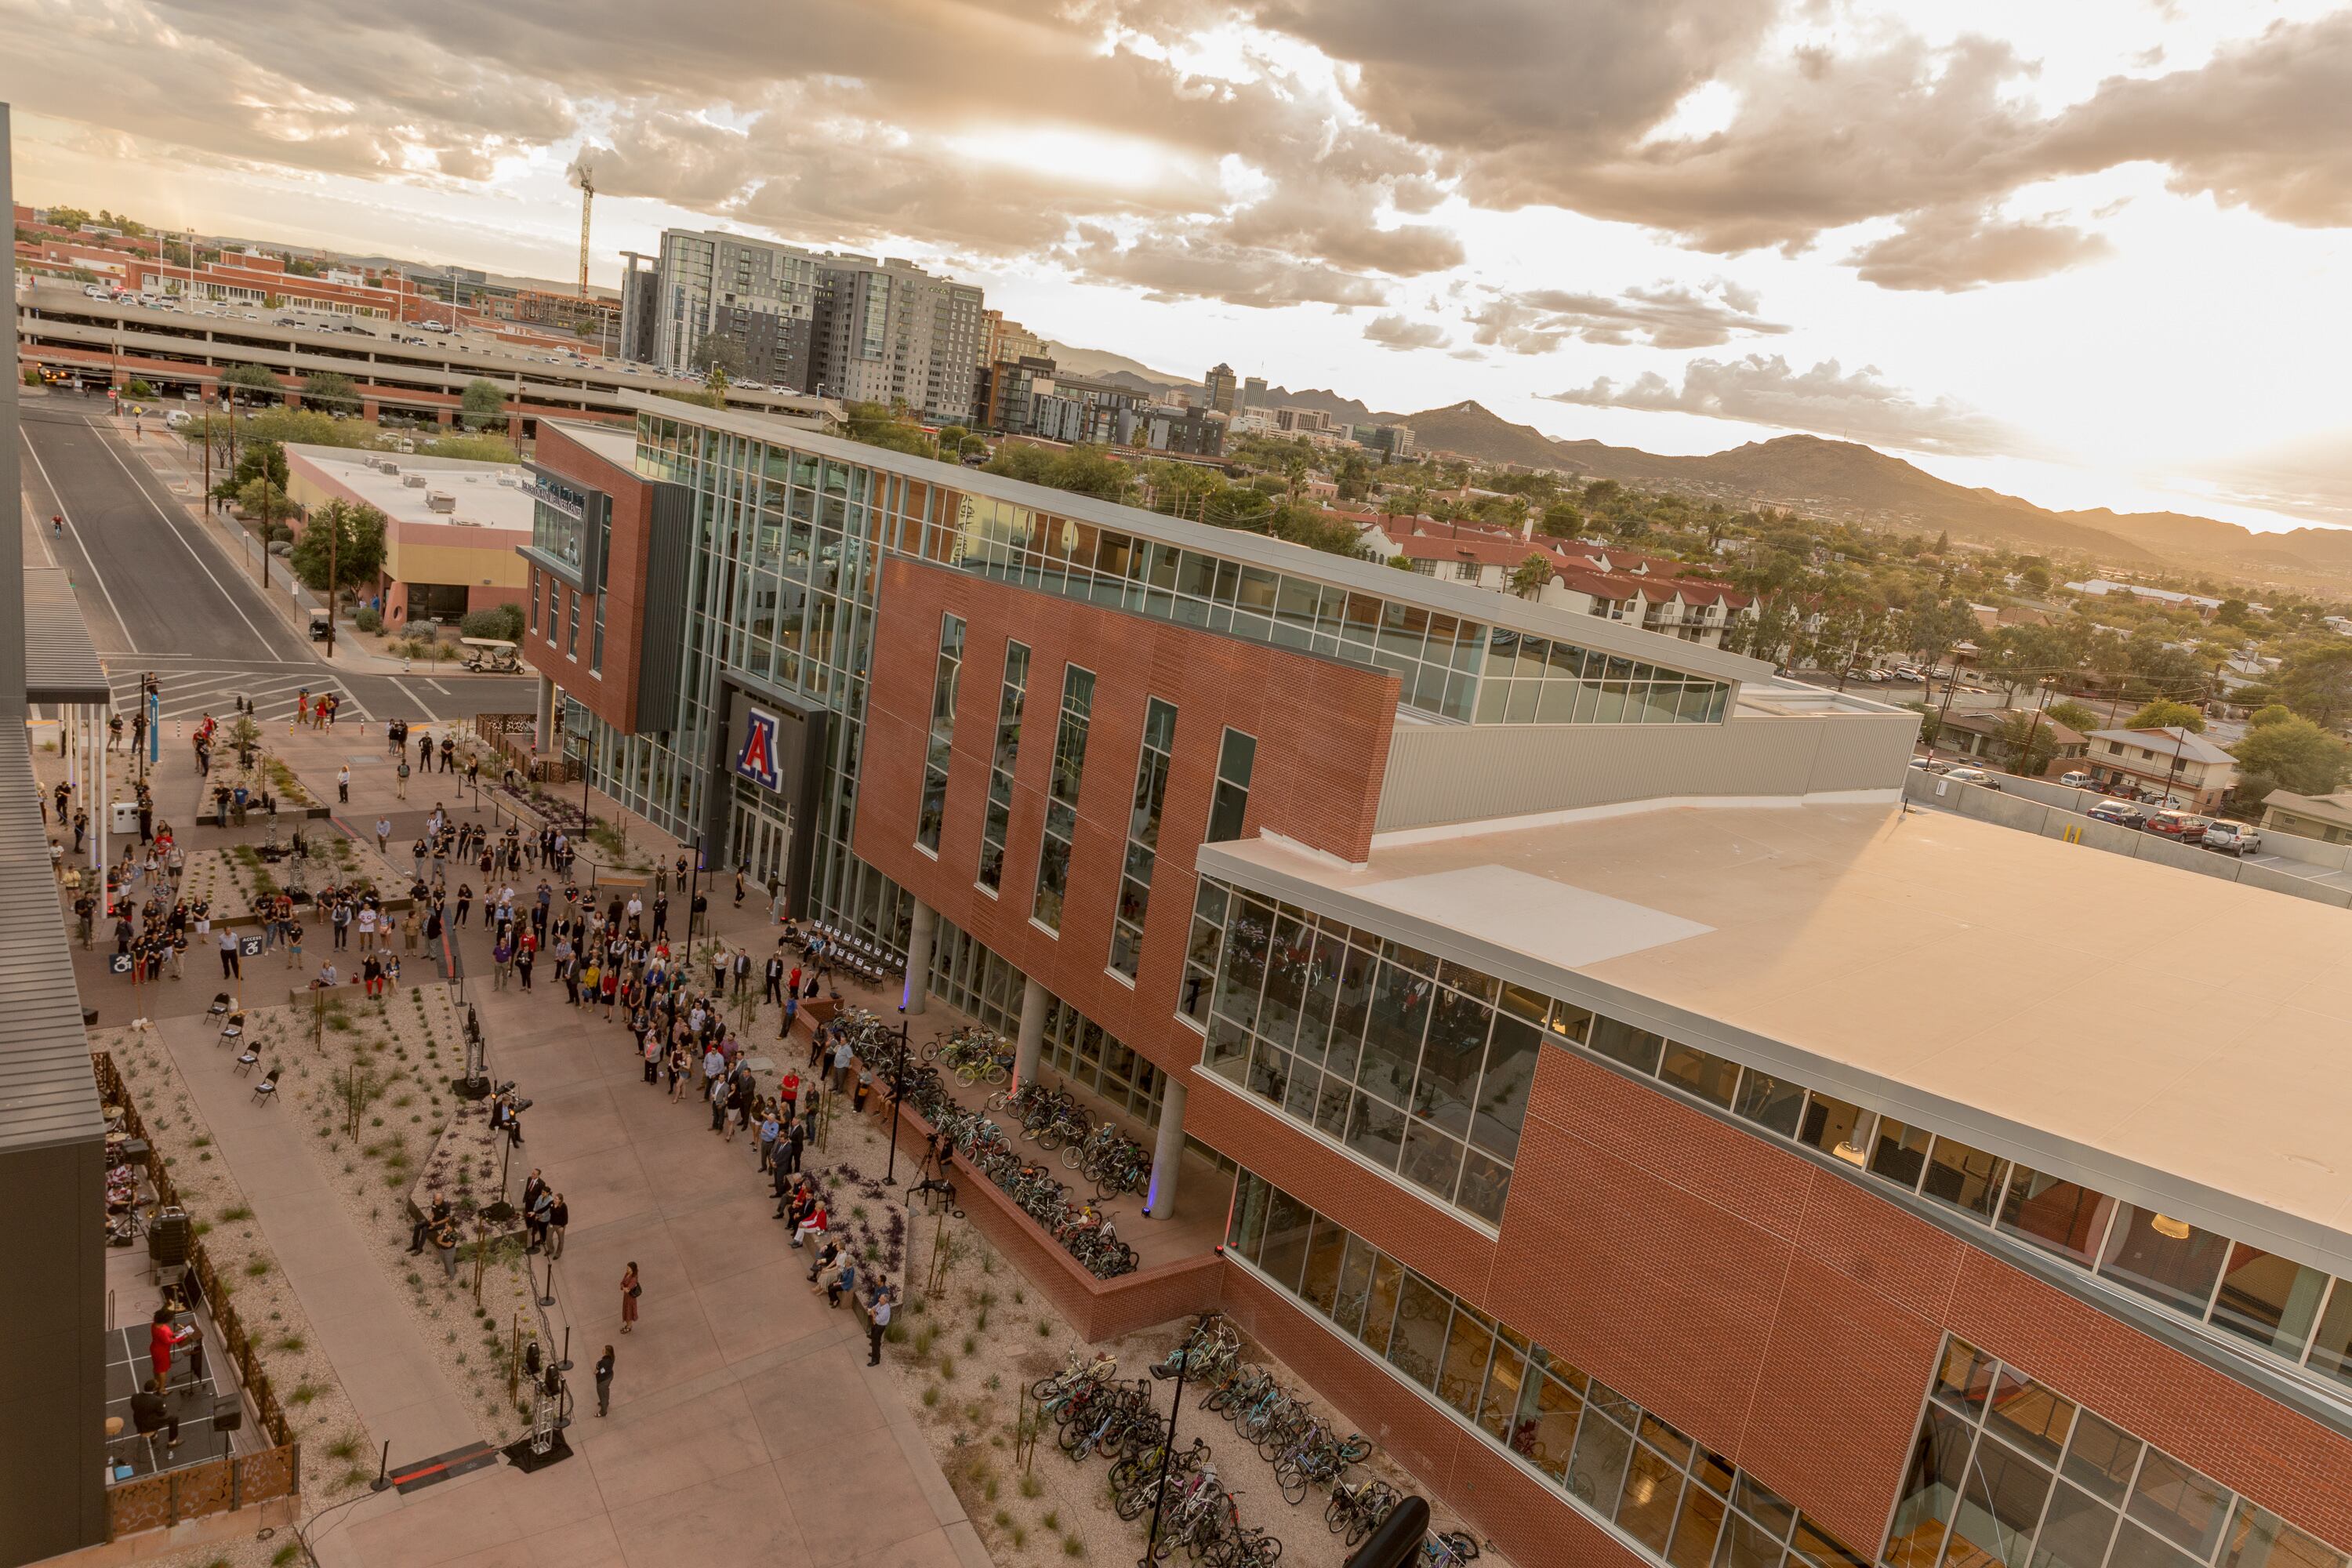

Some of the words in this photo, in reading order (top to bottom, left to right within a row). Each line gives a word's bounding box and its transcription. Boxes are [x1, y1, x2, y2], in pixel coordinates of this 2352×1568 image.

[549, 492, 568, 510] WELLNESS
[568, 502, 583, 517] CENTER
[736, 707, 783, 794] A
